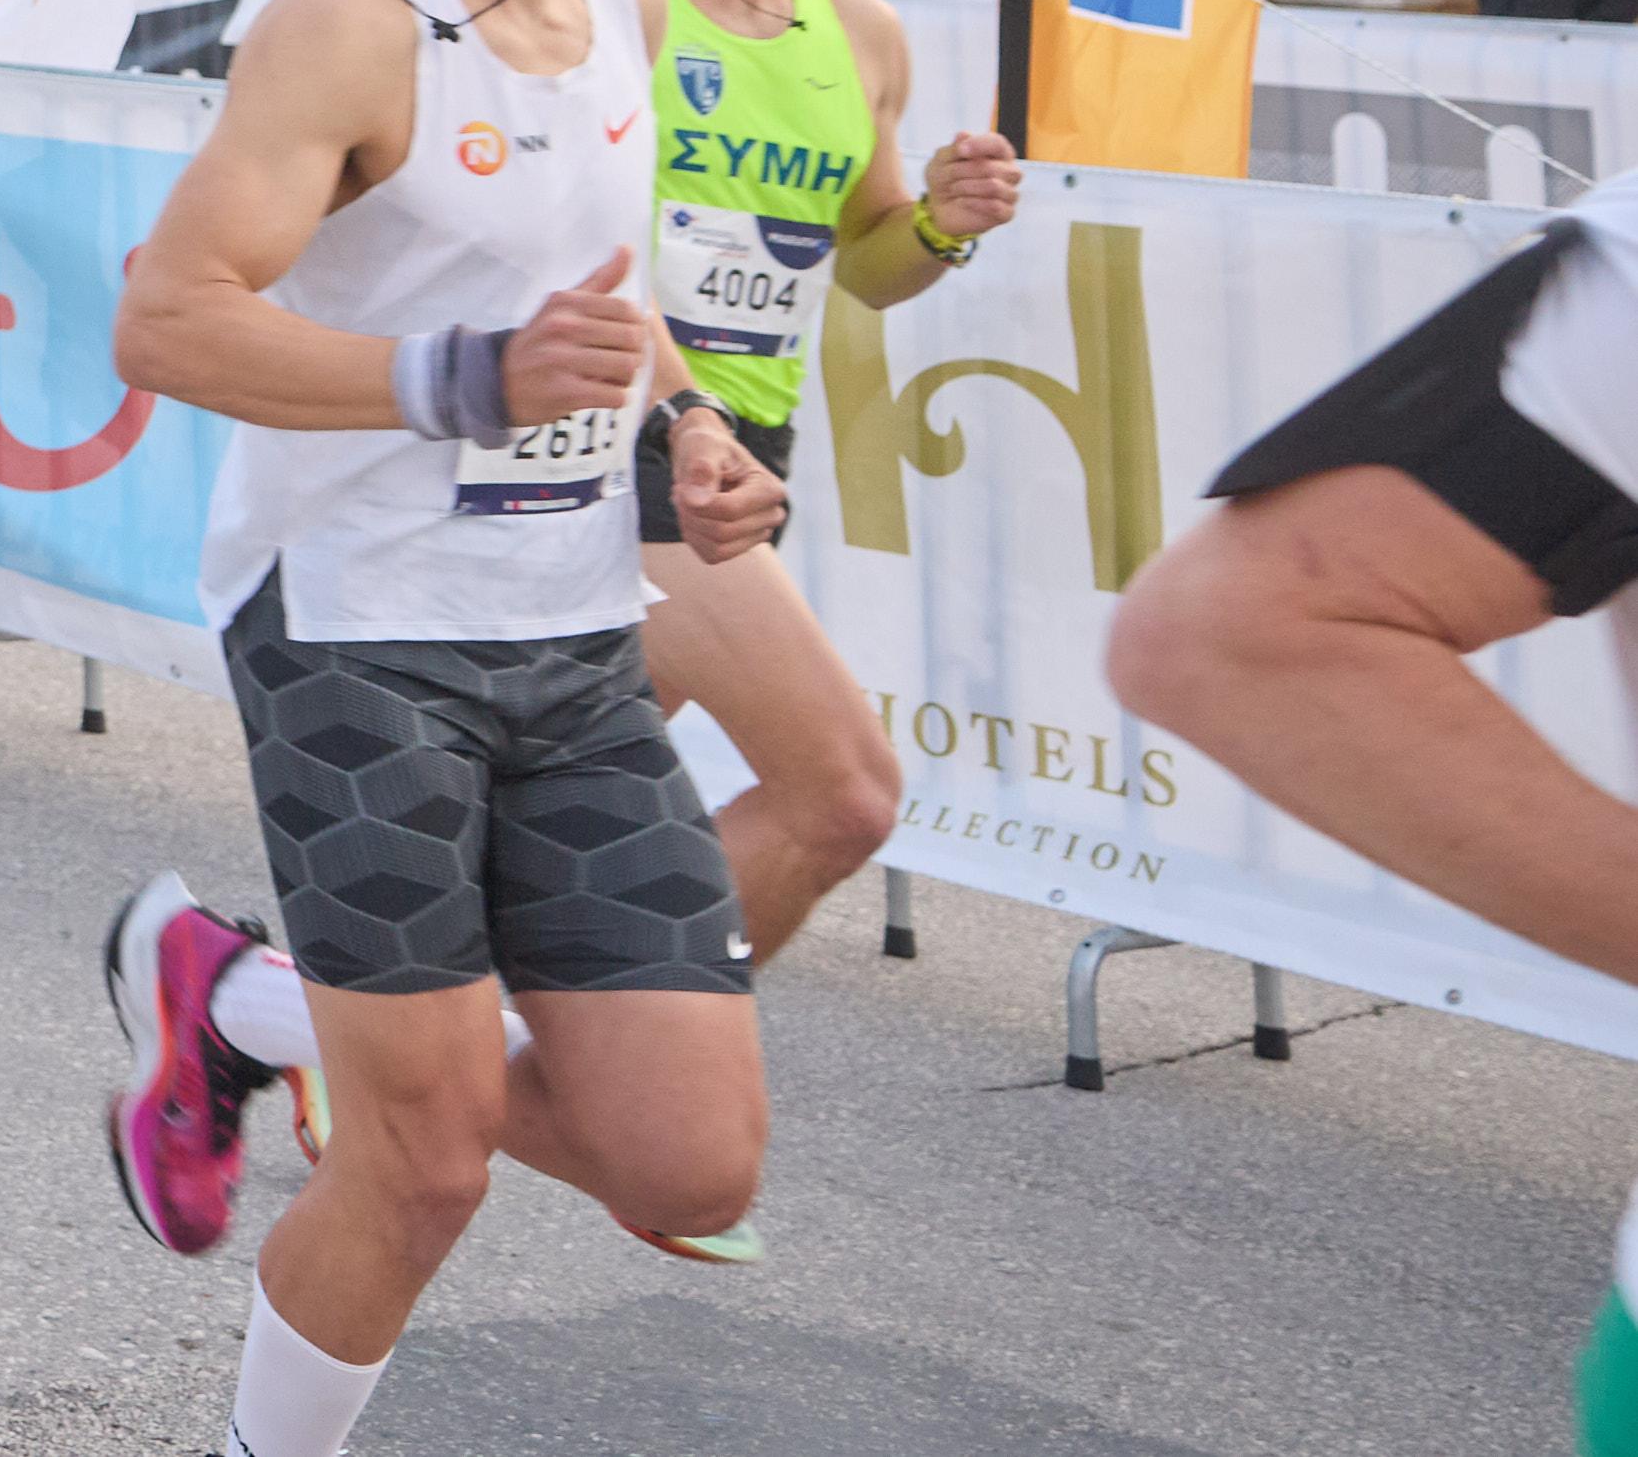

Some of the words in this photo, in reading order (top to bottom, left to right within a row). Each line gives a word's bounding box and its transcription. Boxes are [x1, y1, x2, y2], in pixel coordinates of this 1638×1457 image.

[670, 128, 854, 194] ΣΥΜΗ
[696, 265, 799, 314] 4004
[900, 798, 1167, 883] LLECTION
